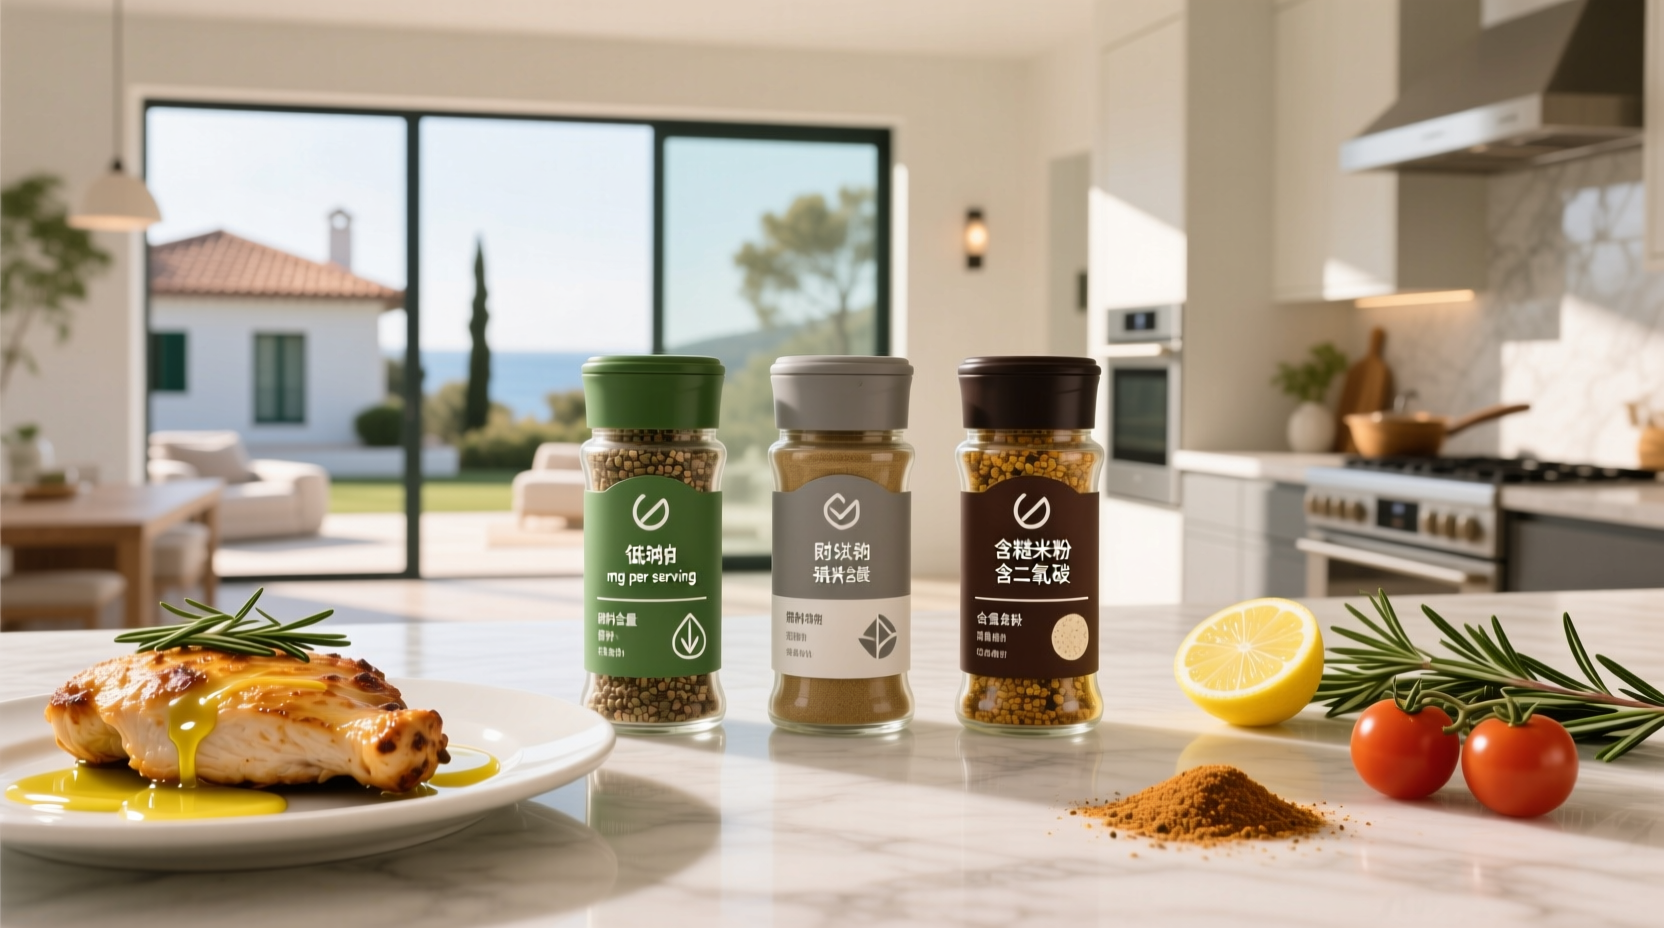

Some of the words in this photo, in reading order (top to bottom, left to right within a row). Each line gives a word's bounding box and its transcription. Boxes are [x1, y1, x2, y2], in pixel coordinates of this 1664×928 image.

[607, 572, 626, 587] mg
[629, 573, 649, 587] per
[652, 569, 697, 587] serving
